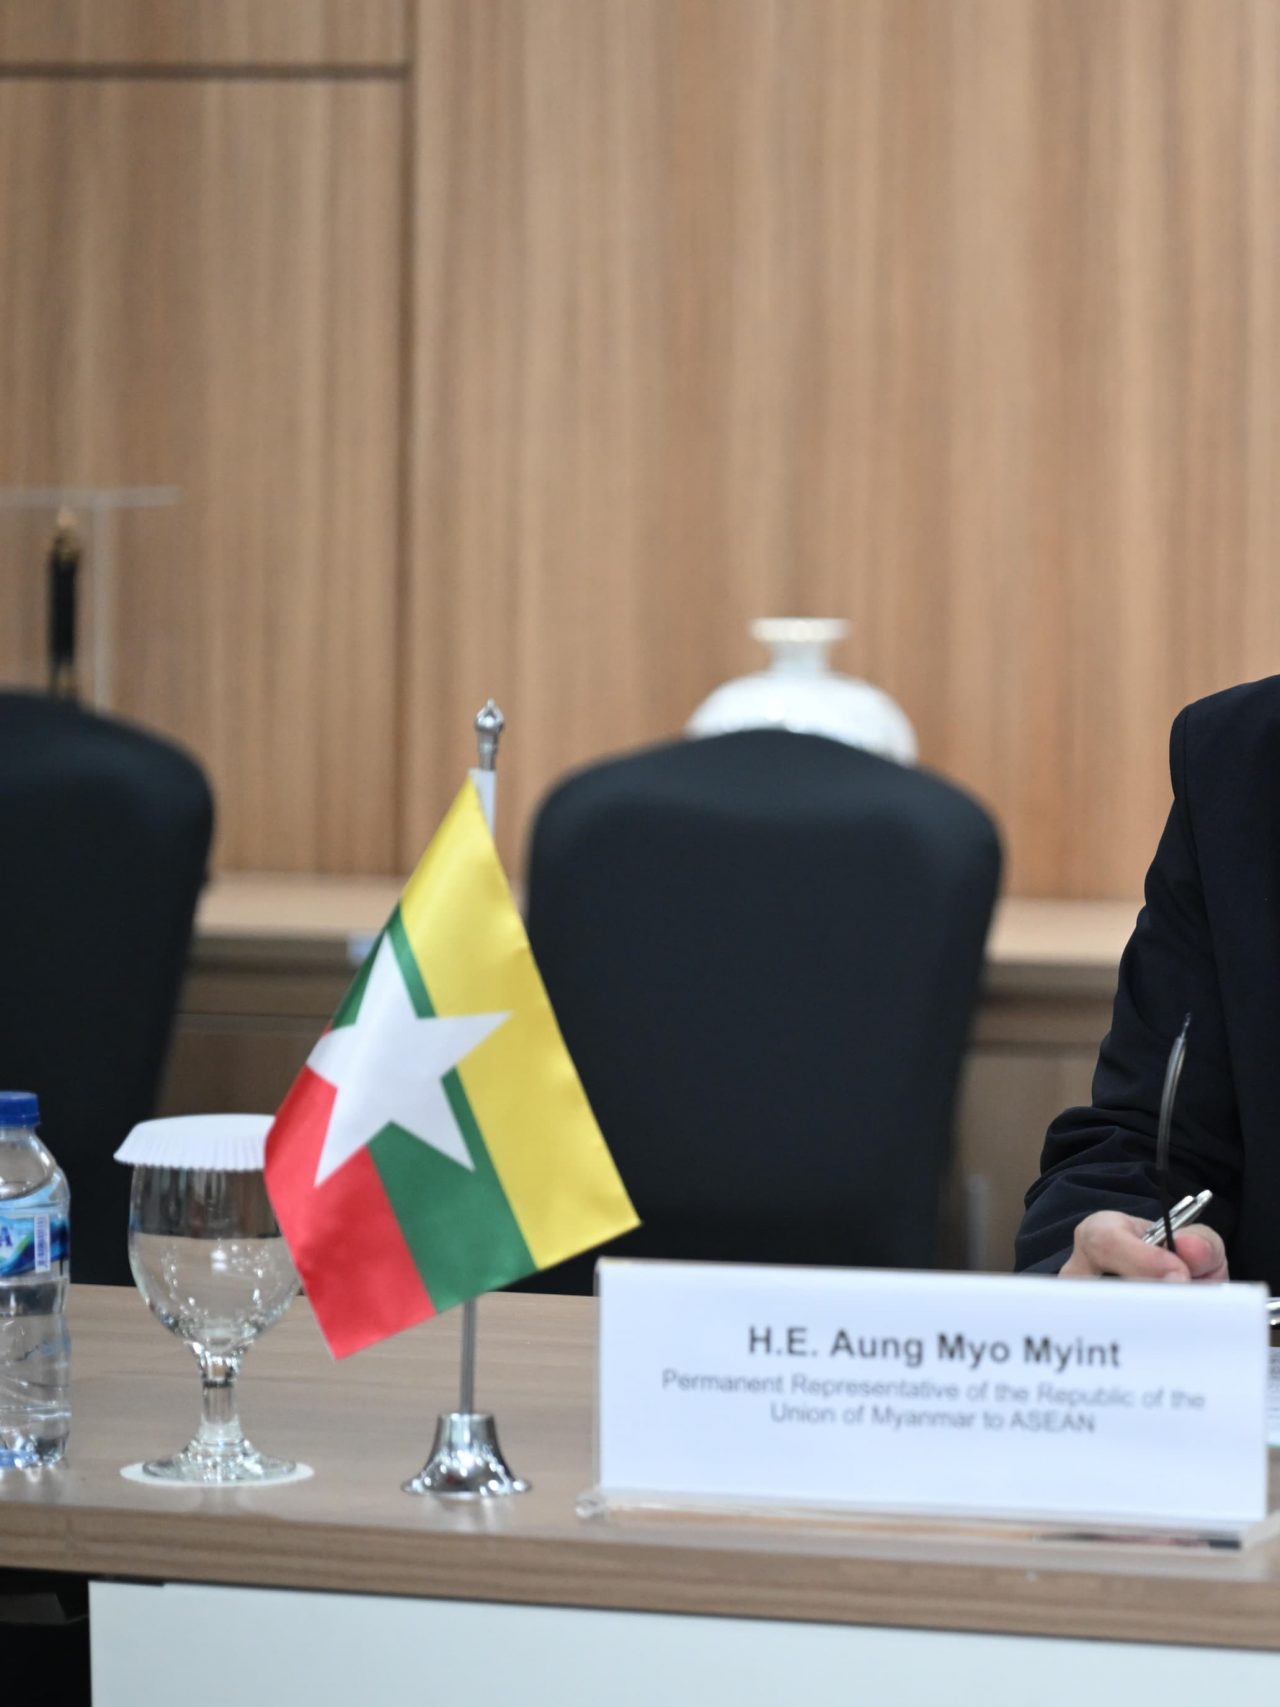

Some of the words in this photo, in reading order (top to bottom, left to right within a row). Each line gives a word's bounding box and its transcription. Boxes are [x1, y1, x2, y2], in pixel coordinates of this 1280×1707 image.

[749, 1326, 817, 1356] H.E.
[830, 1328, 924, 1367] Aung
[937, 1332, 1011, 1370] Myo
[1023, 1335, 1120, 1373] Myint
[662, 1369, 784, 1394] Permanent
[791, 1373, 960, 1399] Representative
[966, 1381, 989, 1401] of
[994, 1383, 1030, 1403] the
[1036, 1383, 1134, 1407] Republic
[1142, 1388, 1165, 1408] of
[1171, 1390, 1205, 1410] the
[770, 1403, 836, 1424] Union
[842, 1404, 865, 1424] of
[871, 1406, 976, 1430] Myanmar
[982, 1410, 1005, 1430] to
[1009, 1410, 1097, 1433] ASEAN
